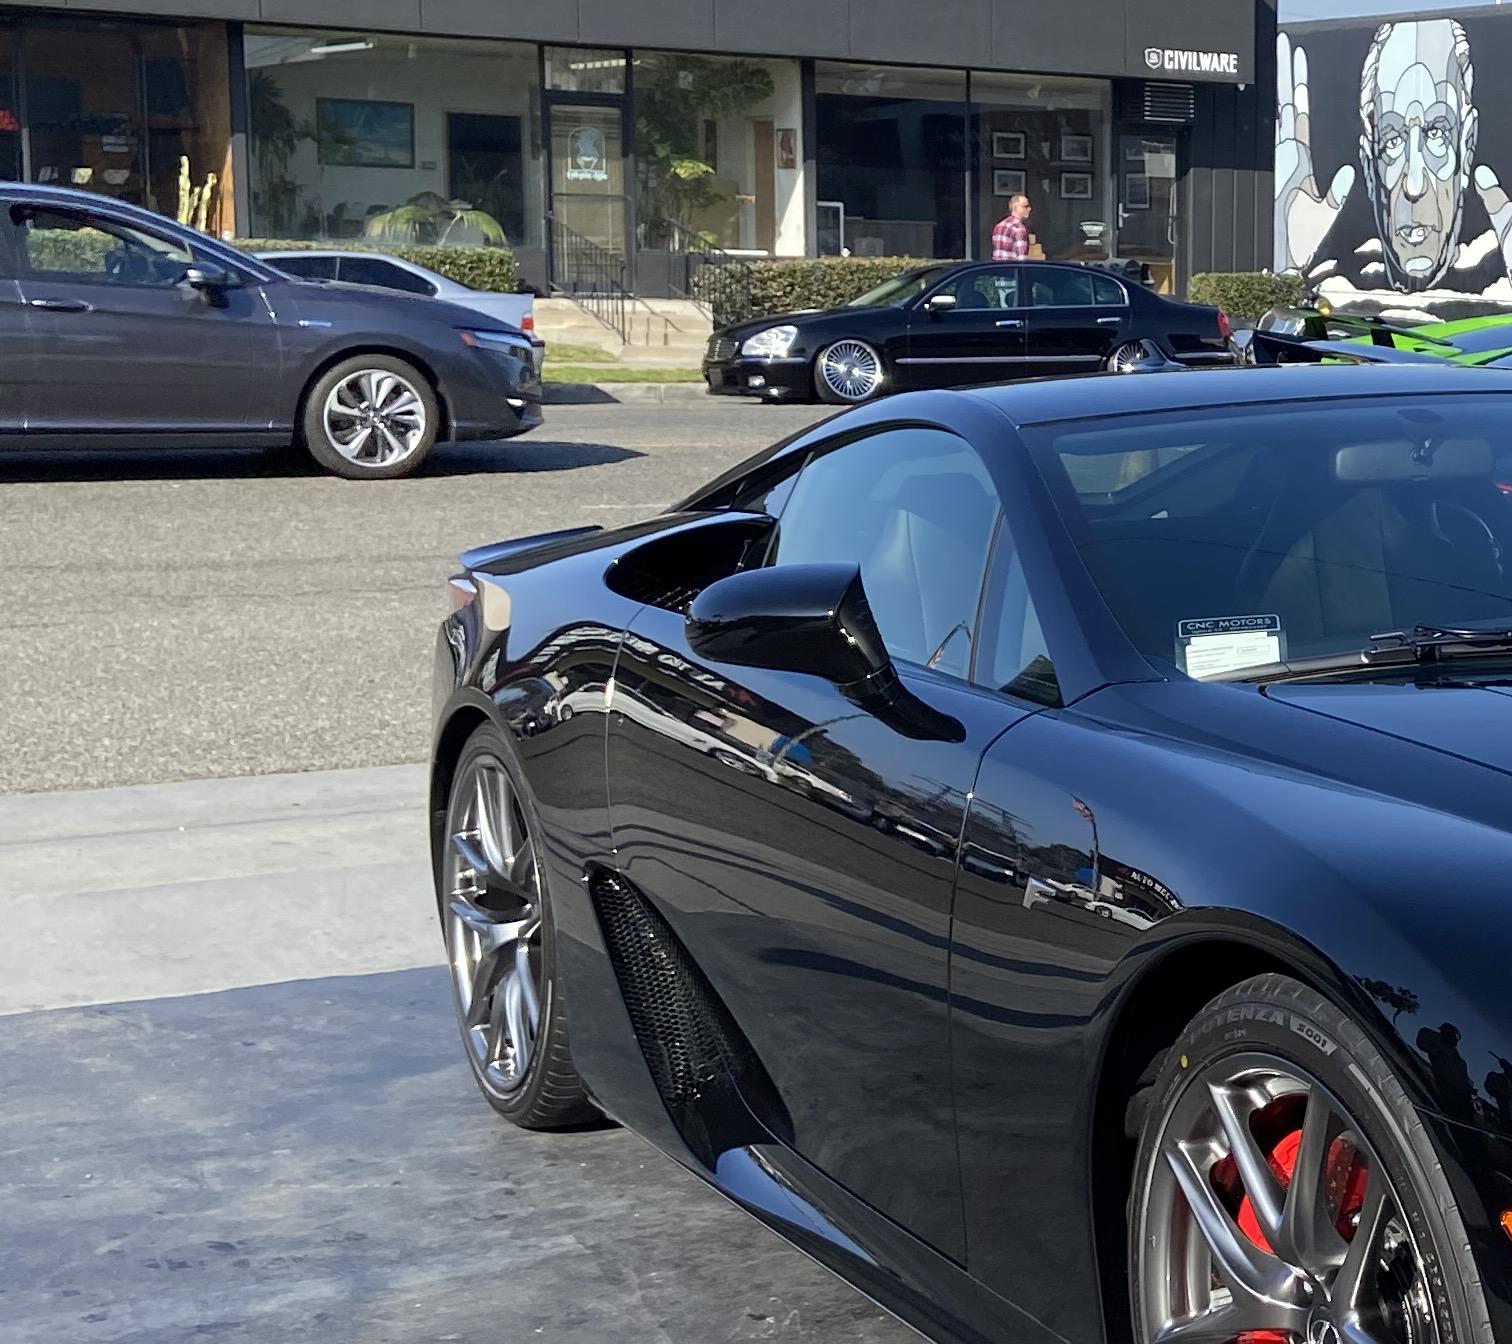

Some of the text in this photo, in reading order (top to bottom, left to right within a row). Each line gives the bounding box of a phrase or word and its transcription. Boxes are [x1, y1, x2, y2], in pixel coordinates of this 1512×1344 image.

[1164, 49, 1238, 73] CIVILWARE
[1186, 621, 1215, 631] CNC
[1218, 617, 1272, 628] MOTORS
